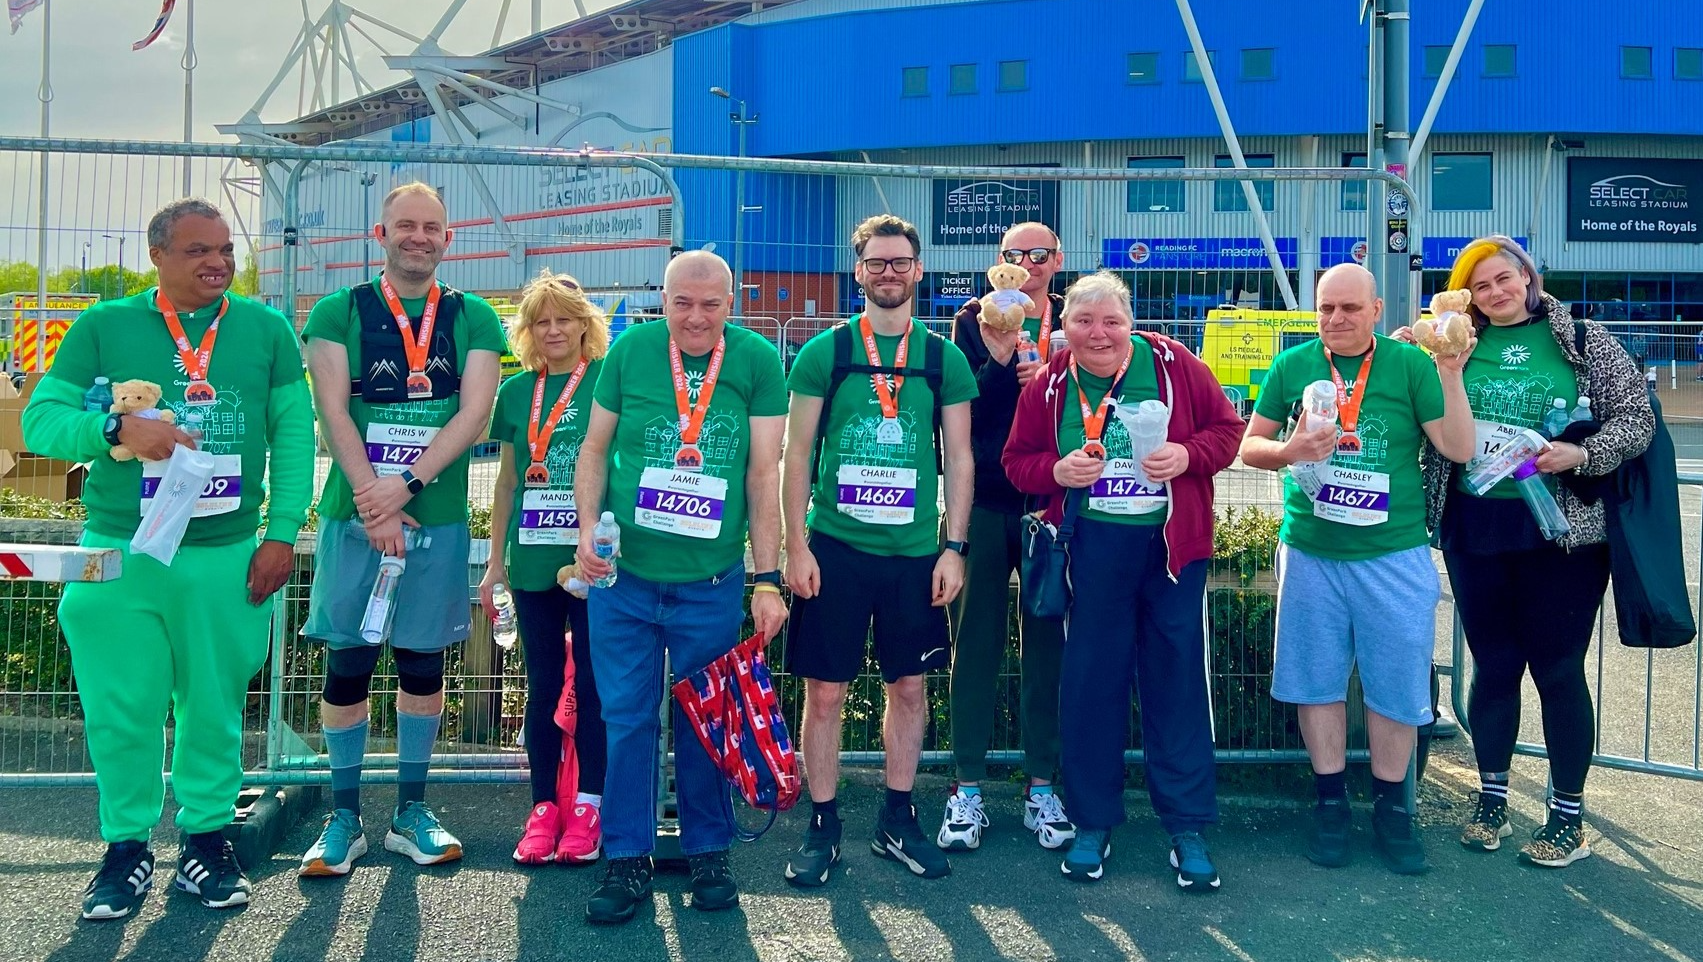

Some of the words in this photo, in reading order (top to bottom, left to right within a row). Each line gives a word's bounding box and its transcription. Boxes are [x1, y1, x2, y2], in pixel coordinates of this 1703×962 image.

[538, 187, 596, 210] LEASING
[602, 177, 670, 200] STADIUM
[948, 193, 1003, 205] SELECT
[1006, 192, 1039, 203] CAR
[1590, 187, 1649, 199] SELECT
[1653, 188, 1687, 199] CAR
[994, 204, 1040, 212] STADIUM
[558, 220, 582, 237] Home
[593, 216, 610, 234] the
[611, 214, 642, 235] Royals
[940, 224, 973, 235] Home
[975, 223, 987, 234] of
[989, 223, 1008, 234] the
[1581, 219, 1617, 231] Home
[1620, 219, 1634, 231] of
[1635, 219, 1655, 231] the
[1658, 220, 1697, 234] Royals
[1154, 253, 1205, 261] FANSTORE
[1221, 248, 1268, 257] macron
[941, 277, 972, 285] TICKET
[419, 317, 432, 347] FINISHER
[426, 302, 435, 317] 2024
[670, 340, 681, 373] FINISHER
[1234, 353, 1261, 361] TRAINING
[707, 351, 722, 384] FINISHER
[559, 375, 580, 404] FINISHER
[576, 361, 586, 376] 2024
[674, 374, 684, 391] 2024
[374, 409, 393, 420] Let's
[396, 411, 405, 421] do
[388, 427, 416, 437] CHRIS
[418, 429, 427, 437] W
[1496, 425, 1517, 436] ABBI
[208, 443, 232, 454] 2024
[382, 446, 423, 463] 1472
[1483, 441, 1501, 455] 14
[1114, 461, 1135, 469] DAV
[670, 473, 701, 486] JAMIE
[860, 468, 897, 479] CHARLIE
[1333, 469, 1373, 482] CHASLEY
[540, 493, 575, 501] MANDY
[855, 487, 906, 505] 14667
[1328, 487, 1380, 508] 14677
[655, 492, 711, 517] 14706
[537, 511, 577, 527] 1459
